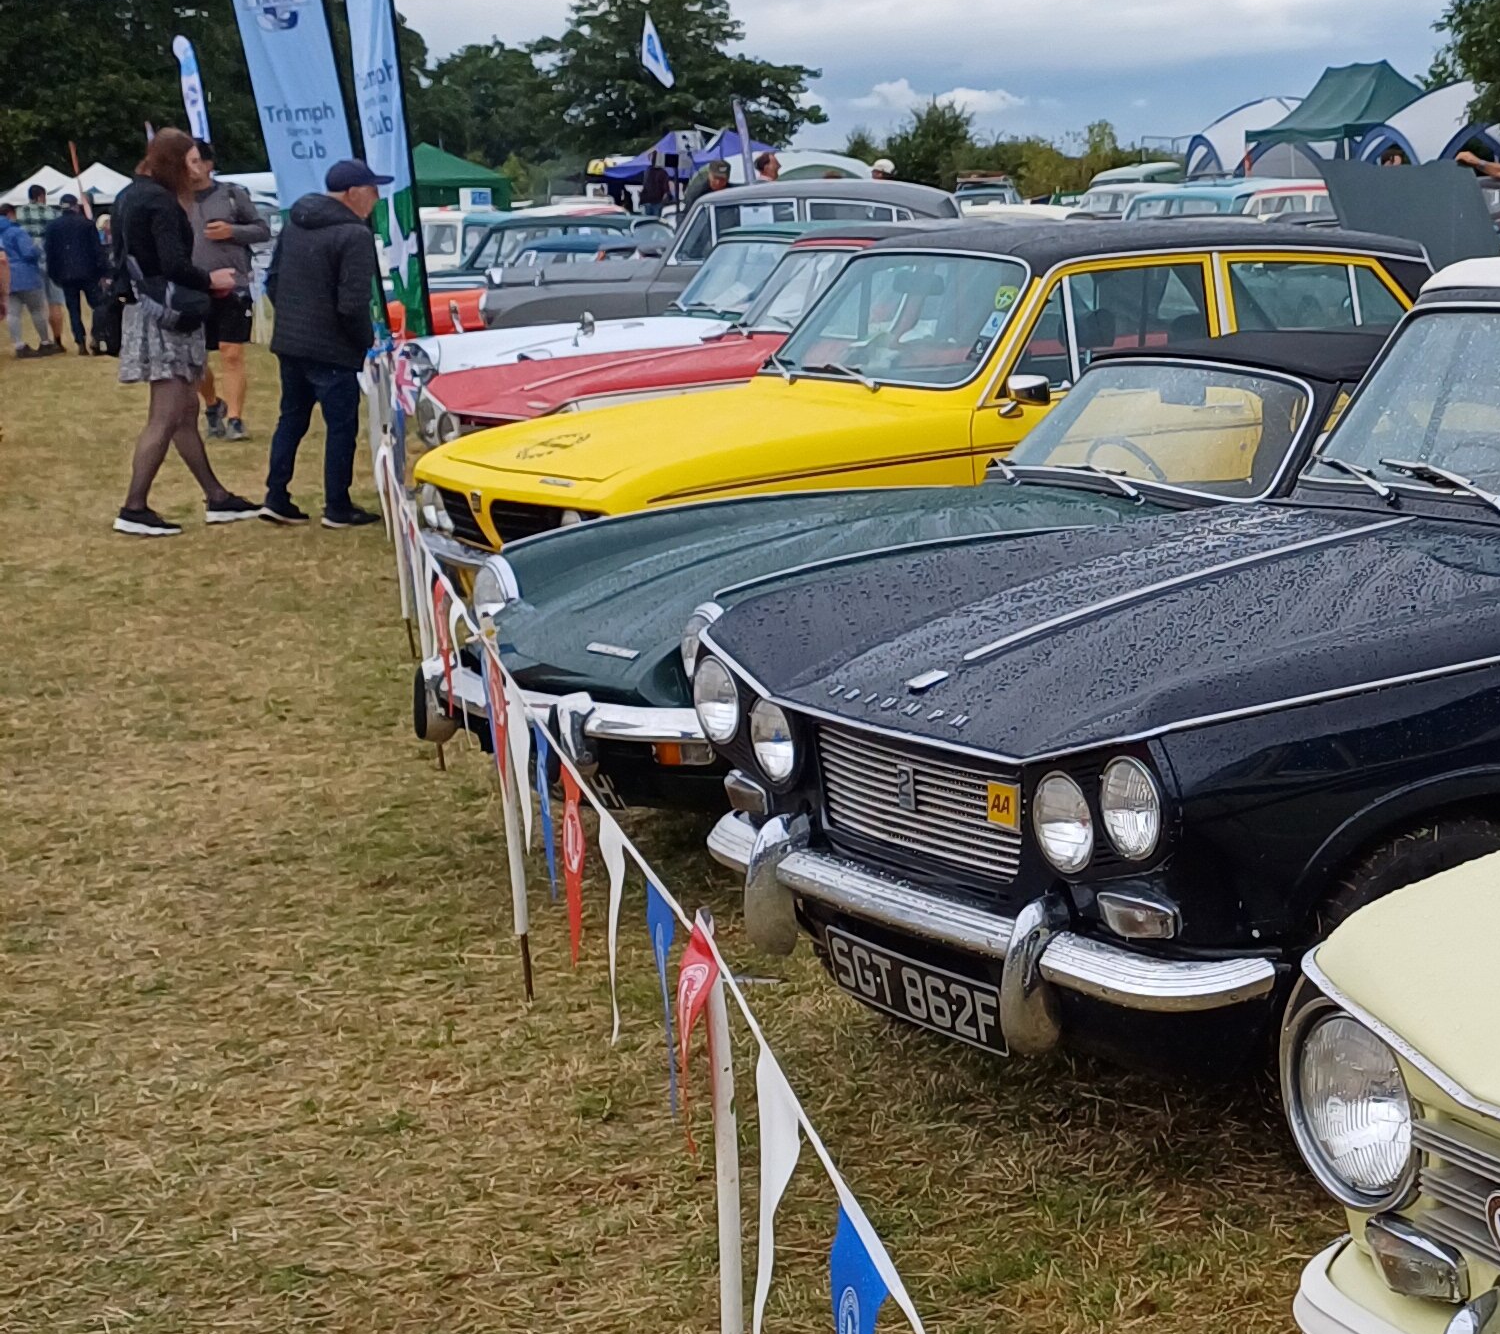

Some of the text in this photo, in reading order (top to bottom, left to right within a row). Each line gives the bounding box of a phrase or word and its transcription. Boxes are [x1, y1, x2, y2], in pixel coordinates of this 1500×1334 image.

[828, 684, 970, 727] TRIUMPH
[990, 793, 1011, 815] AA
[831, 936, 998, 1043] SGT 862F
